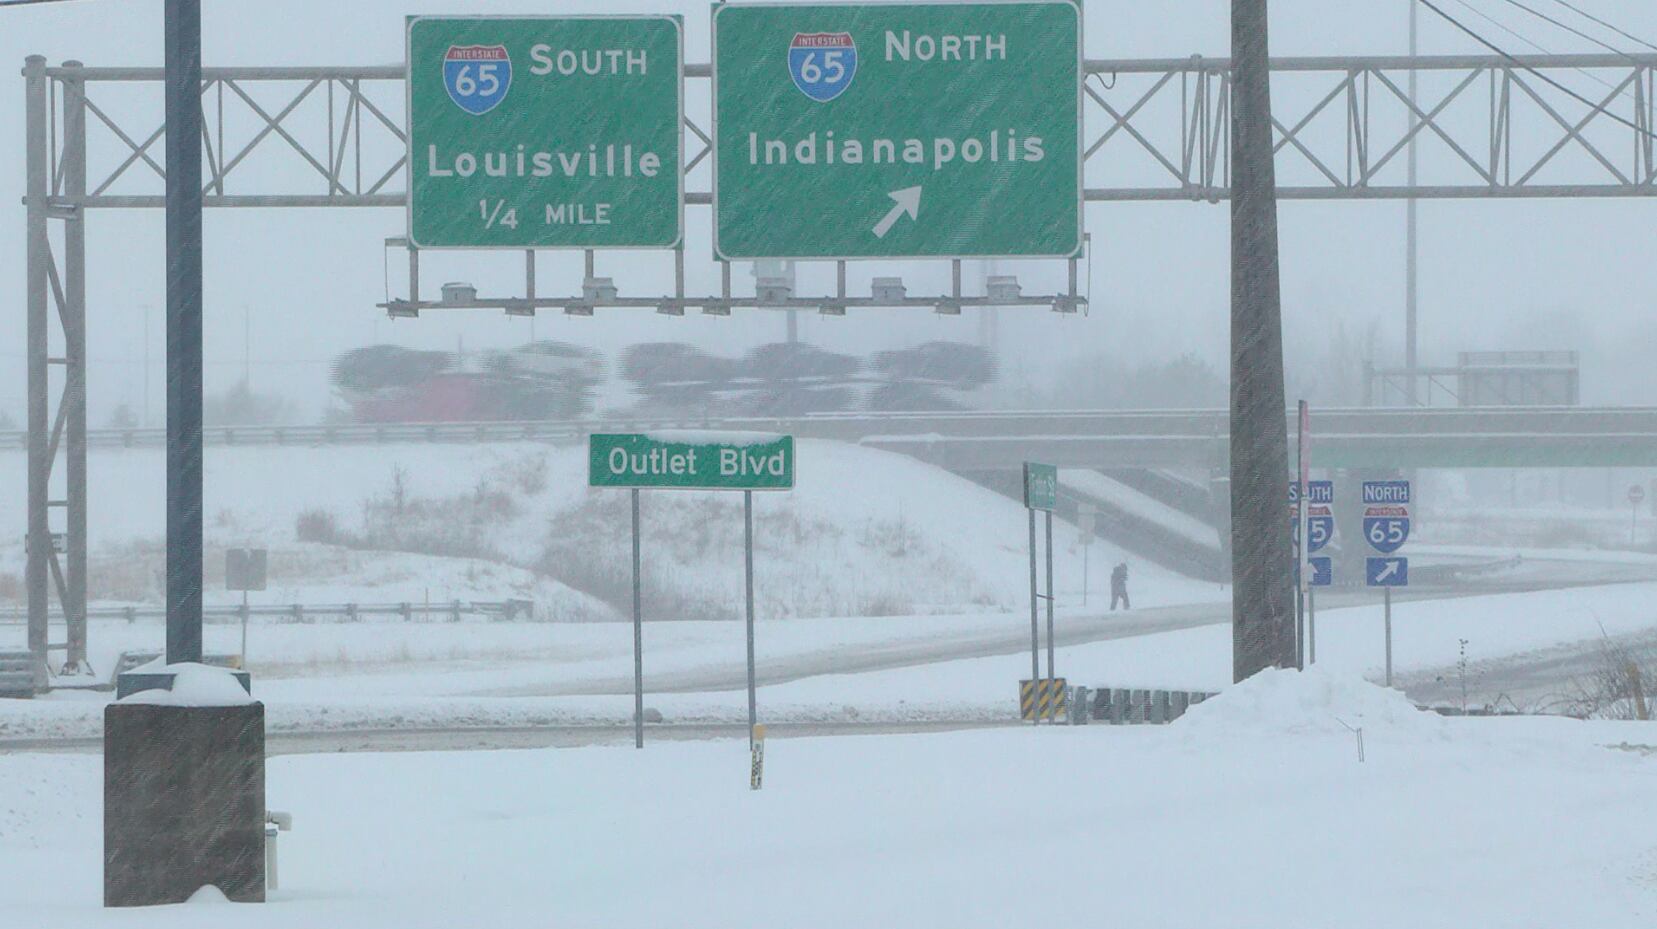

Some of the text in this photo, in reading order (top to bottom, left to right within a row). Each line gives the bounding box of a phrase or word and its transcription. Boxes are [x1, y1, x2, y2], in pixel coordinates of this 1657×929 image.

[453, 49, 501, 59] INTERSTATE
[799, 37, 847, 46] INTERSTATE
[455, 64, 499, 97] 65
[801, 52, 845, 84] 65
[428, 144, 661, 177] Louisville
[750, 128, 1045, 171] Indianapolis
[479, 199, 611, 229] 1/4 MILE
[608, 447, 785, 476] Outlet Blvd
[1365, 486, 1408, 500] NORTH
[1370, 521, 1403, 543] 65
